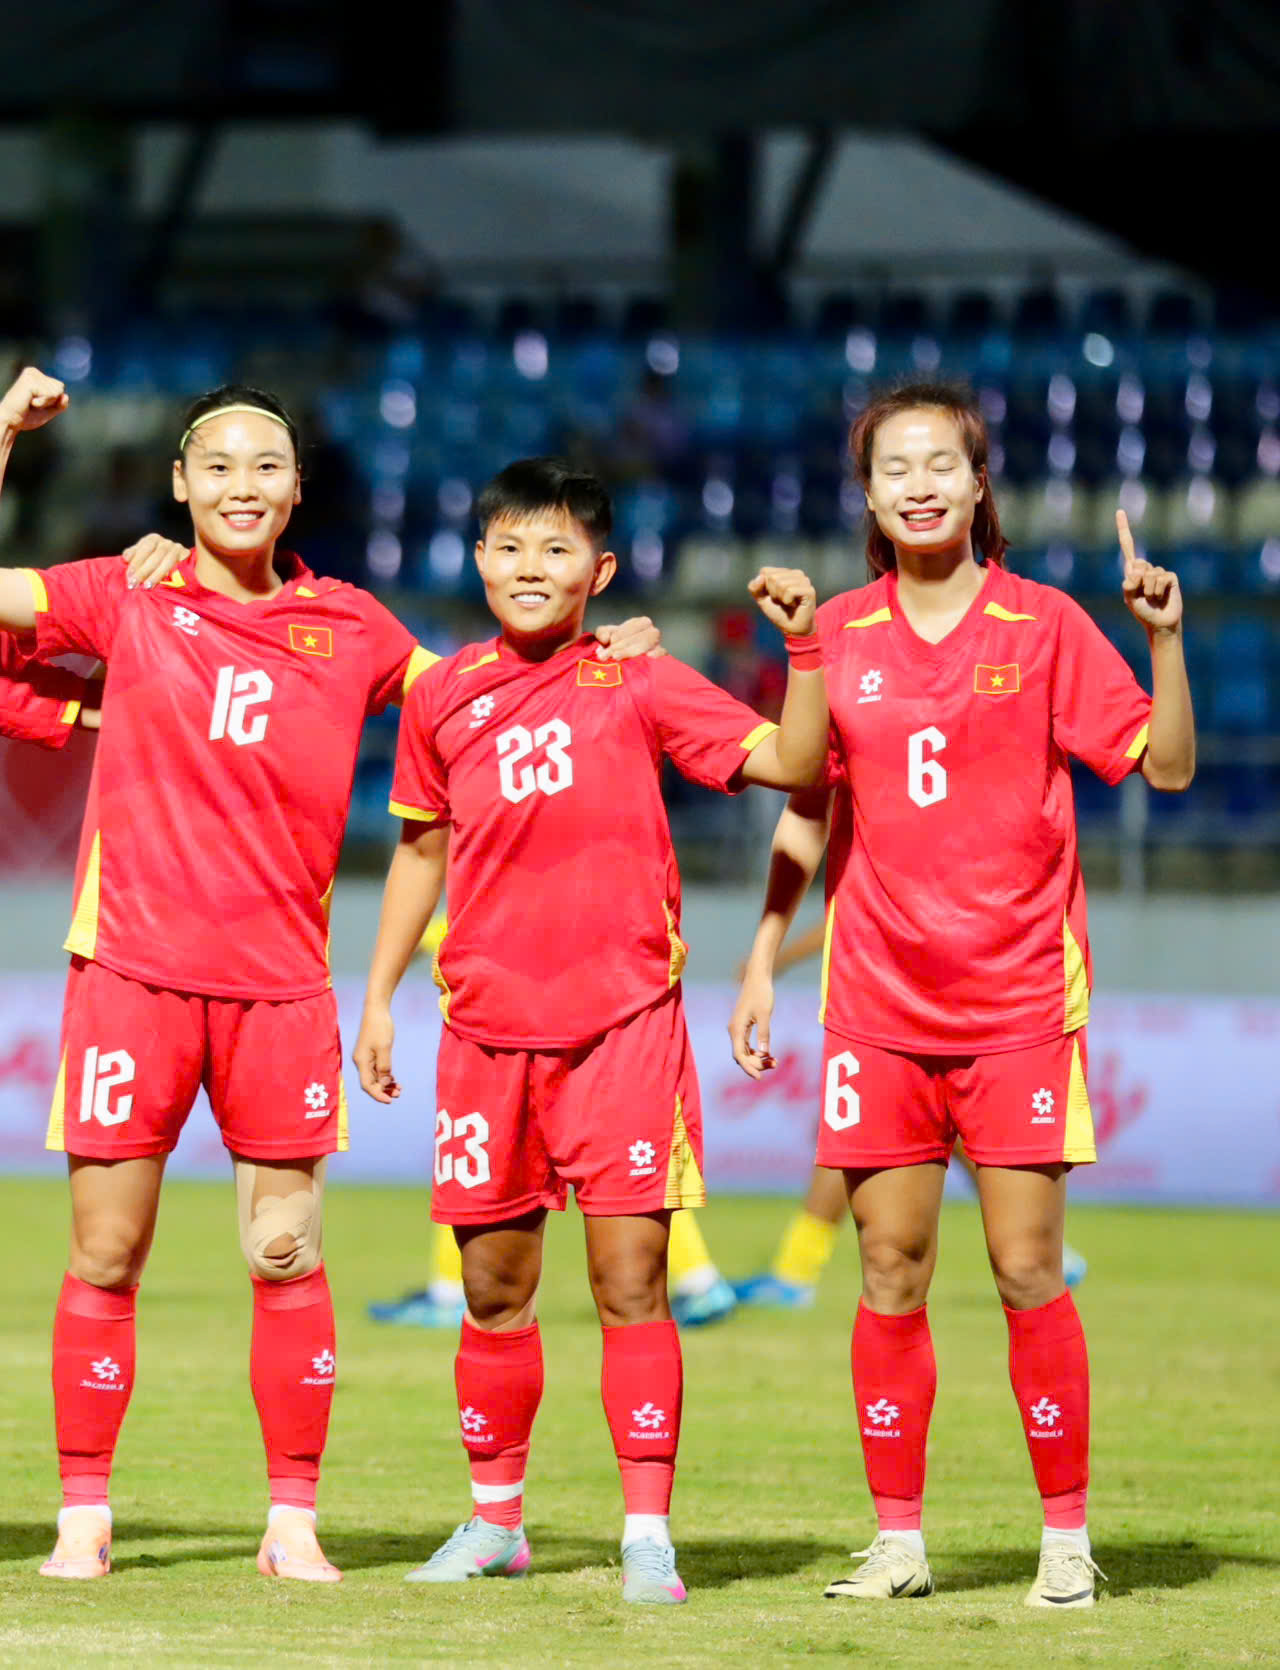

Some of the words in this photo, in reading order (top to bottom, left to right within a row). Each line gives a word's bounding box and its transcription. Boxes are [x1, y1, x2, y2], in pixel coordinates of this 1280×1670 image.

[208, 665, 274, 746] 12
[495, 717, 574, 804] 23
[907, 725, 948, 809] 6
[79, 1045, 136, 1127] 12
[823, 1050, 861, 1132] 6
[433, 1107, 492, 1190] 23
